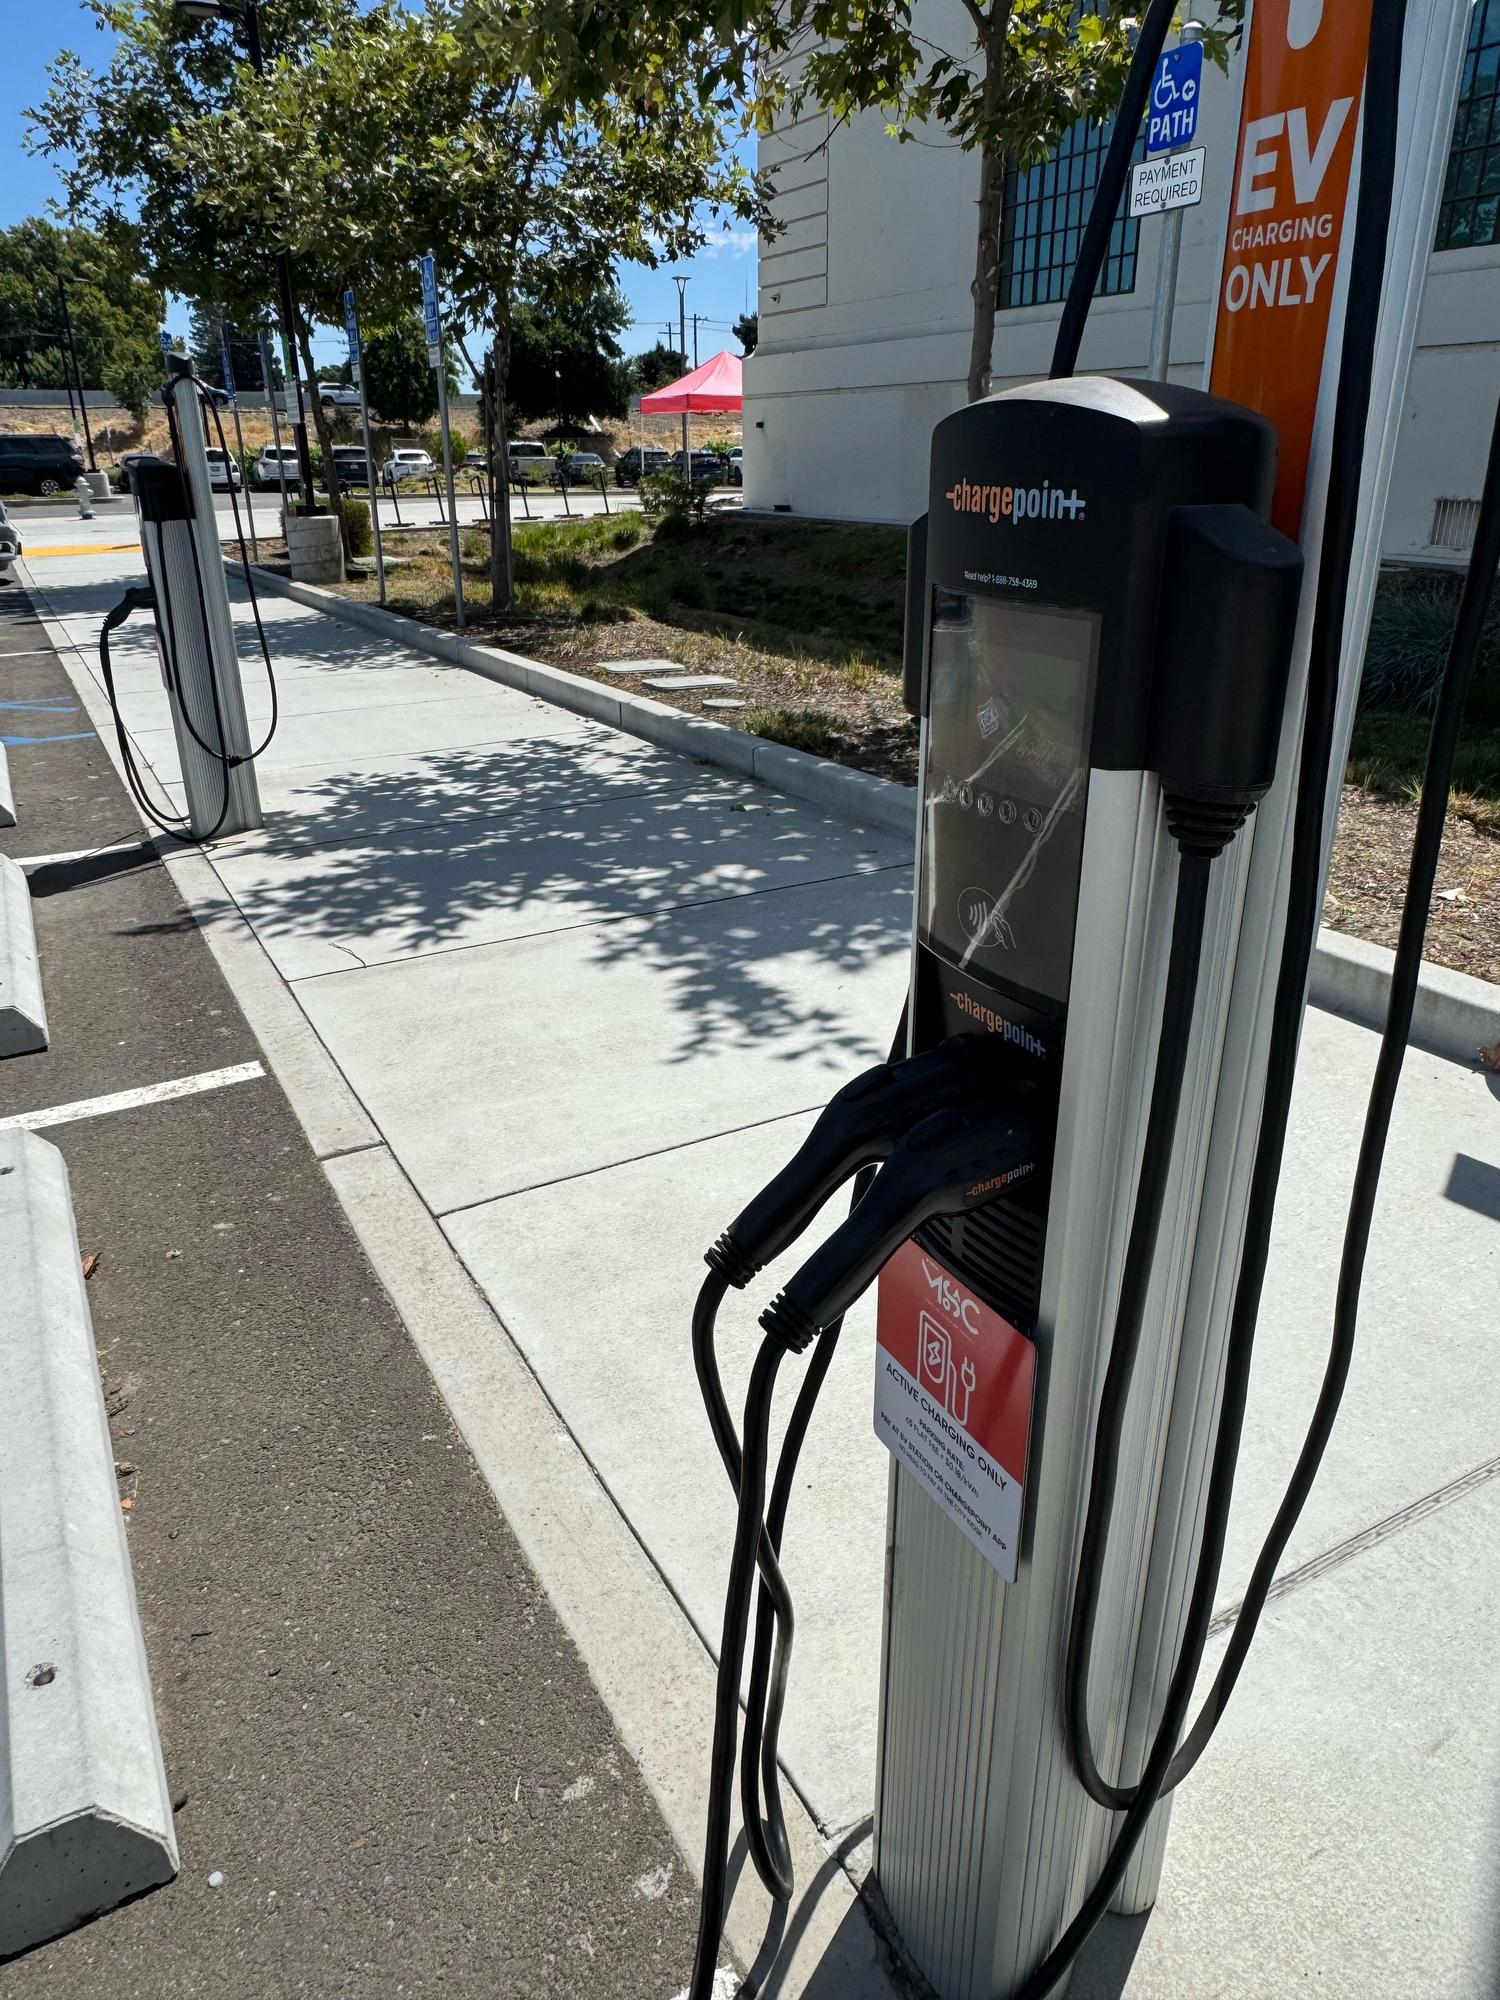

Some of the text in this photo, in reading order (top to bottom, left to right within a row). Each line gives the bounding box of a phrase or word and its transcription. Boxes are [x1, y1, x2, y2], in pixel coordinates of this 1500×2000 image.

[1149, 107, 1194, 144] PATH
[1139, 158, 1197, 186] PAYMENT
[1236, 96, 1354, 216] EV
[1134, 179, 1198, 208] REQUIRED
[1231, 213, 1333, 251] CHARGING
[1225, 253, 1333, 312] ONLY
[886, 1362, 1007, 1491] ACTIVE CHARGING ONLY
